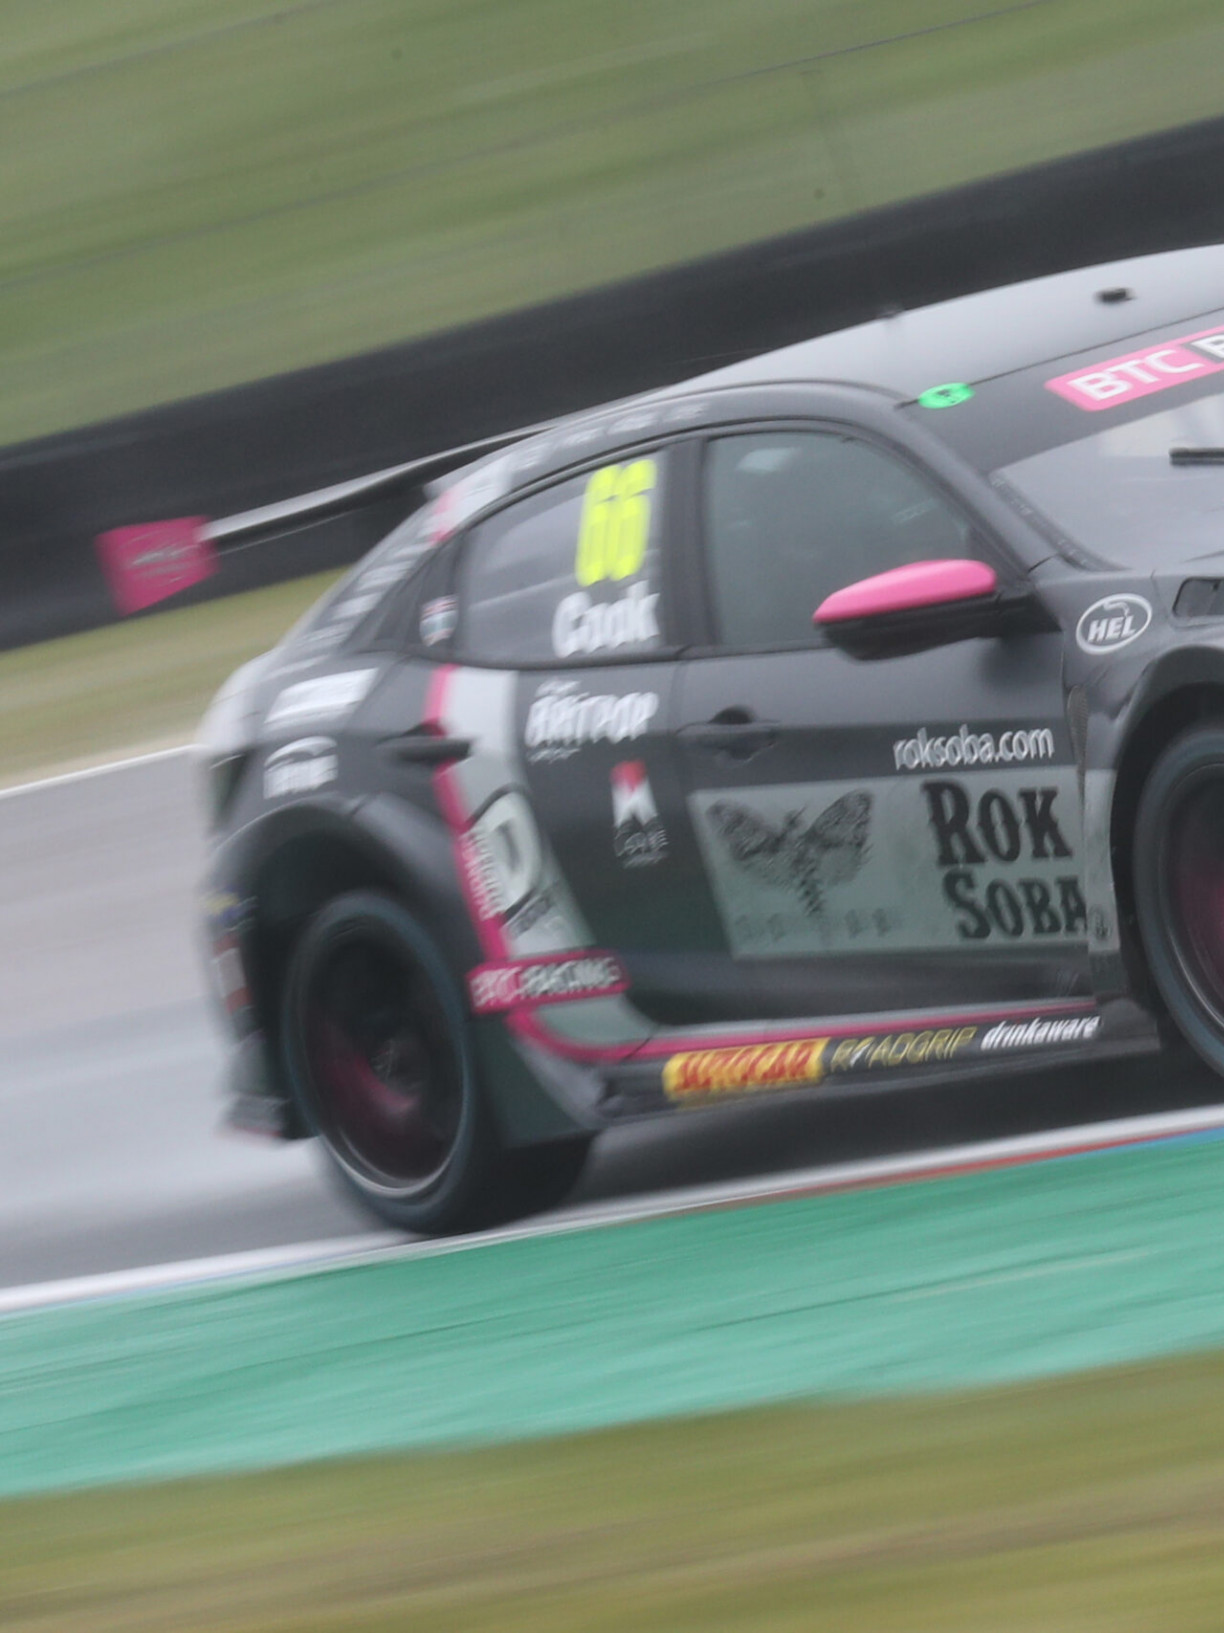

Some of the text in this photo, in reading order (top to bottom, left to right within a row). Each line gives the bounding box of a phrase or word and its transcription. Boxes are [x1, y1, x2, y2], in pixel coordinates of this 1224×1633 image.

[1067, 349, 1204, 400] BTC
[575, 459, 658, 587] 66
[1087, 615, 1136, 642] HEL
[893, 724, 1055, 770] roksoba.com
[921, 778, 1074, 867] ROK
[943, 867, 1091, 940] SOBA
[980, 1016, 1101, 1051] drinkaware
